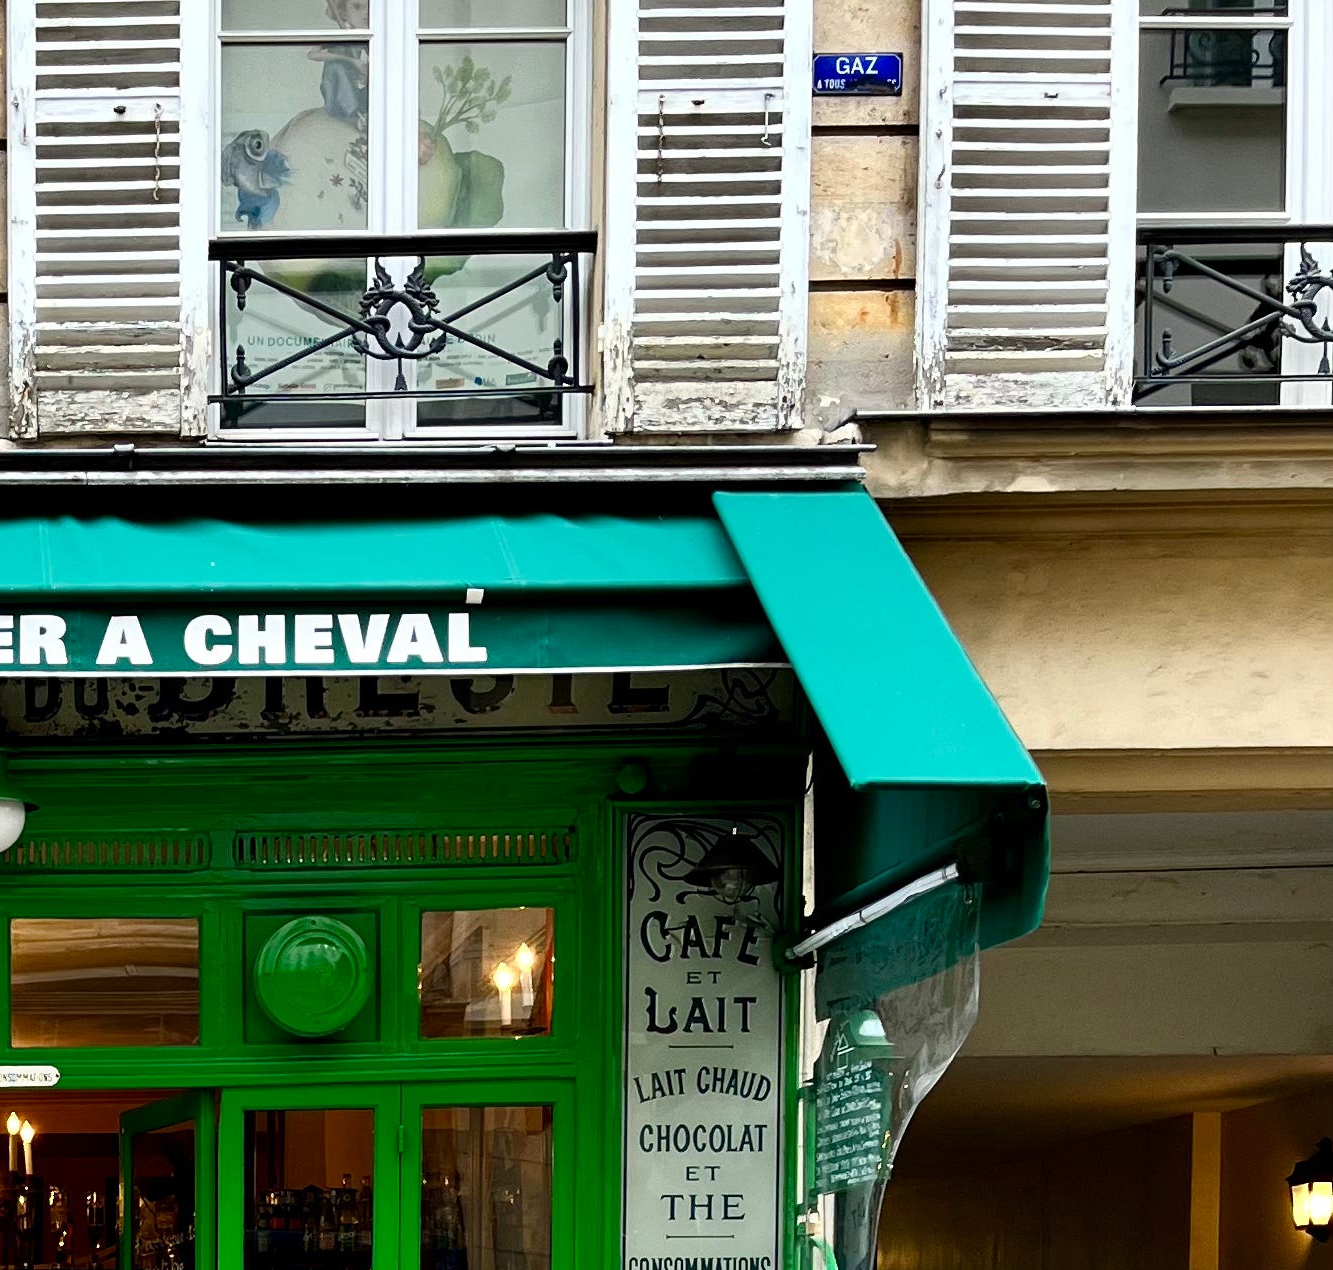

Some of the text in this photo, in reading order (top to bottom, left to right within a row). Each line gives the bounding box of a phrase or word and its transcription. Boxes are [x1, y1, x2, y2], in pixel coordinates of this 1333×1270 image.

[835, 56, 878, 75] GAZ
[816, 79, 823, 89] A
[824, 78, 846, 89] TOUS
[95, 614, 154, 665] A
[183, 612, 488, 665] CHEVAL
[685, 971, 722, 984] ET
[644, 986, 757, 1034] LAIT
[633, 1066, 771, 1103] LAIT CHAUD
[639, 1123, 767, 1153] CHOCOLAT
[685, 1165, 721, 1181] ET
[660, 1193, 746, 1220] THE
